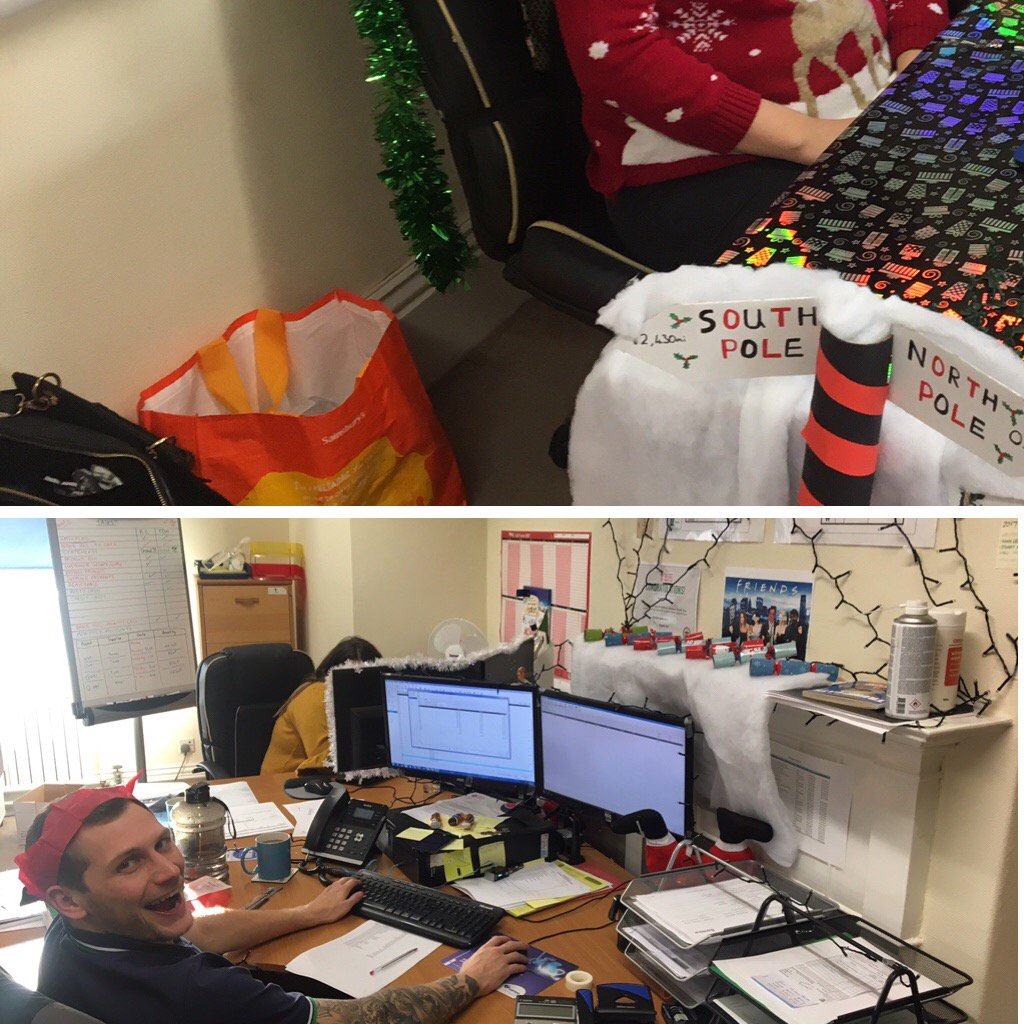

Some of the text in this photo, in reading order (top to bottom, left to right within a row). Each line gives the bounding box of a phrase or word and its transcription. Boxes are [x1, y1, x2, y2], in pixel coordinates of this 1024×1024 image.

[698, 306, 818, 334] SOUTH
[633, 333, 687, 347] 2,430mi
[721, 337, 804, 359] POLE
[907, 339, 999, 412] NORTH
[918, 380, 986, 440] POLE
[736, 579, 799, 596] FRIENDS
